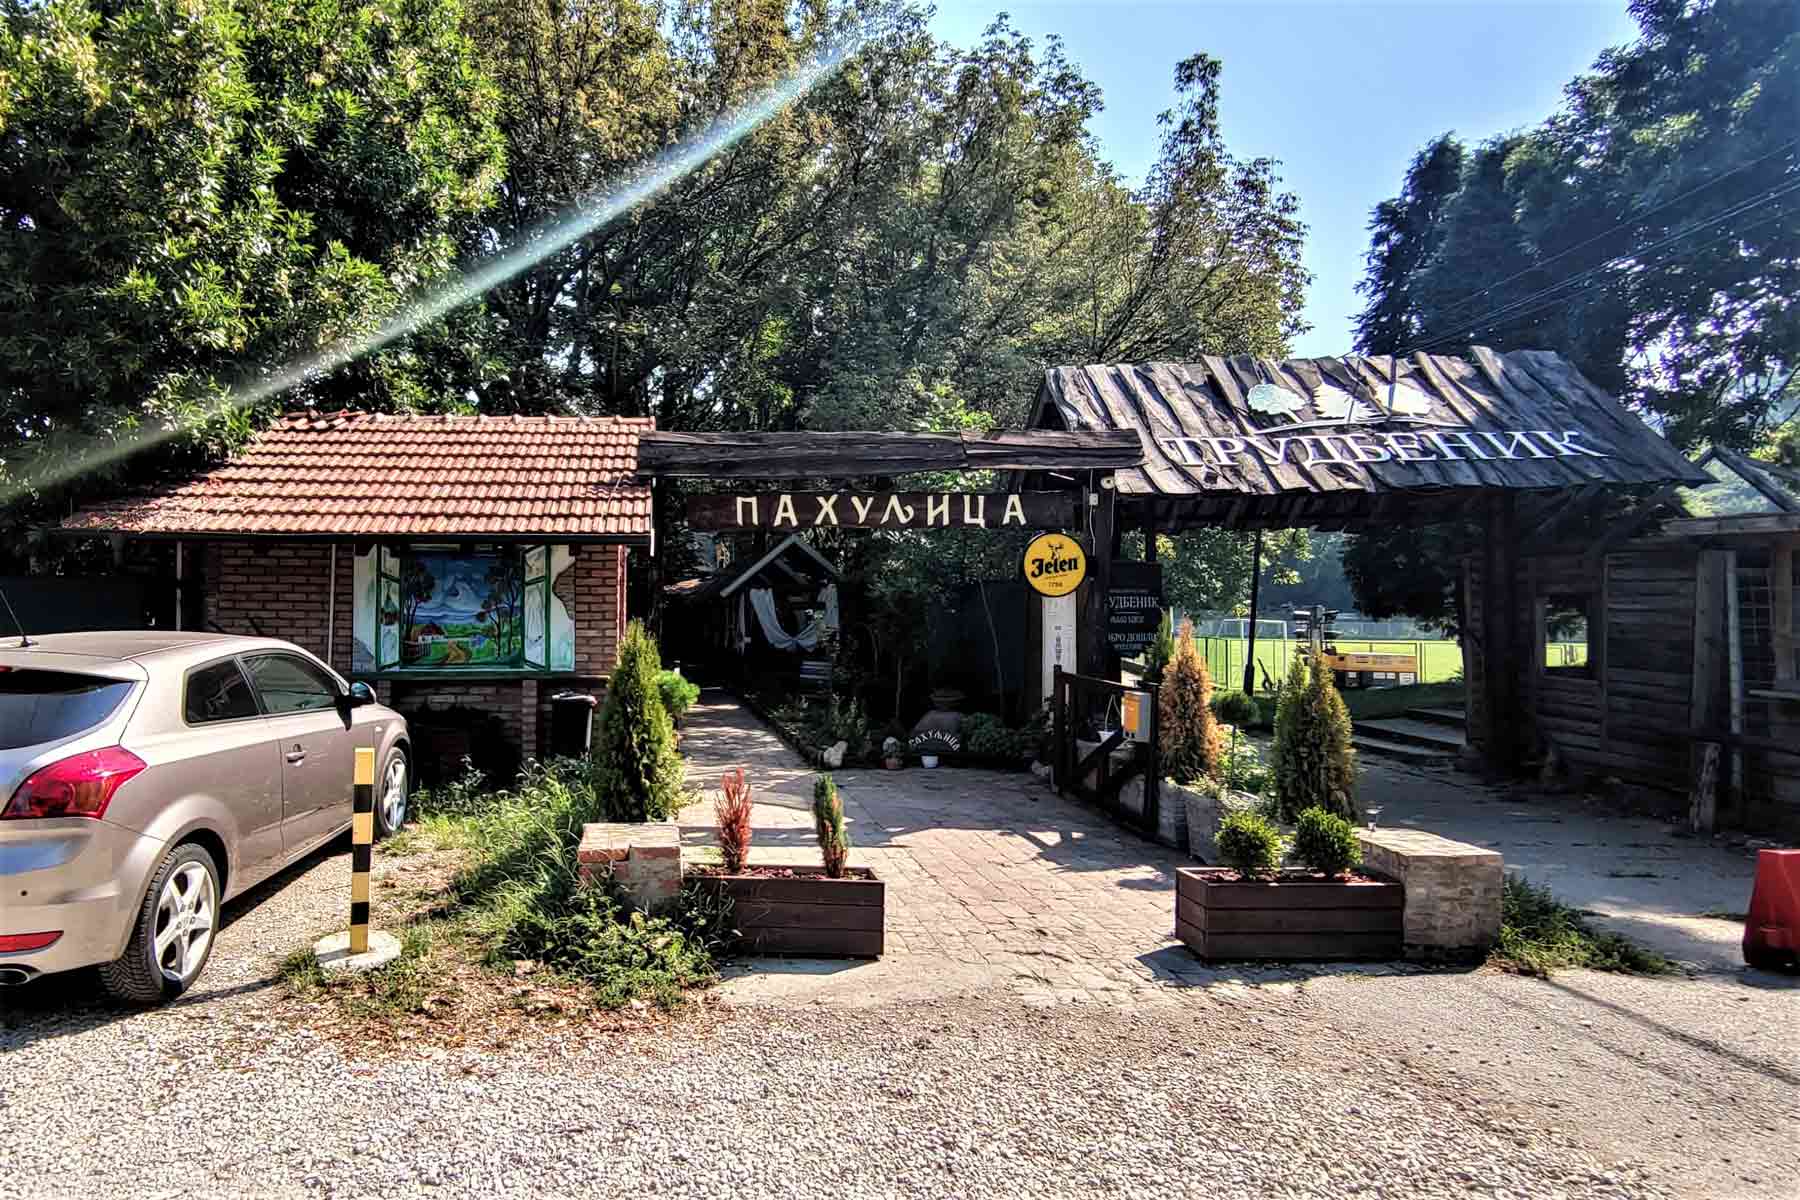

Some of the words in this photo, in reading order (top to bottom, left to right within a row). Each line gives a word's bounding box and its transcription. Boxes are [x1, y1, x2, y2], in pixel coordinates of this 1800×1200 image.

[1160, 431, 1609, 471] ТРУДБЕНИК
[735, 493, 1027, 528] ПАХУЉИЦА
[1031, 557, 1079, 578] Jelen
